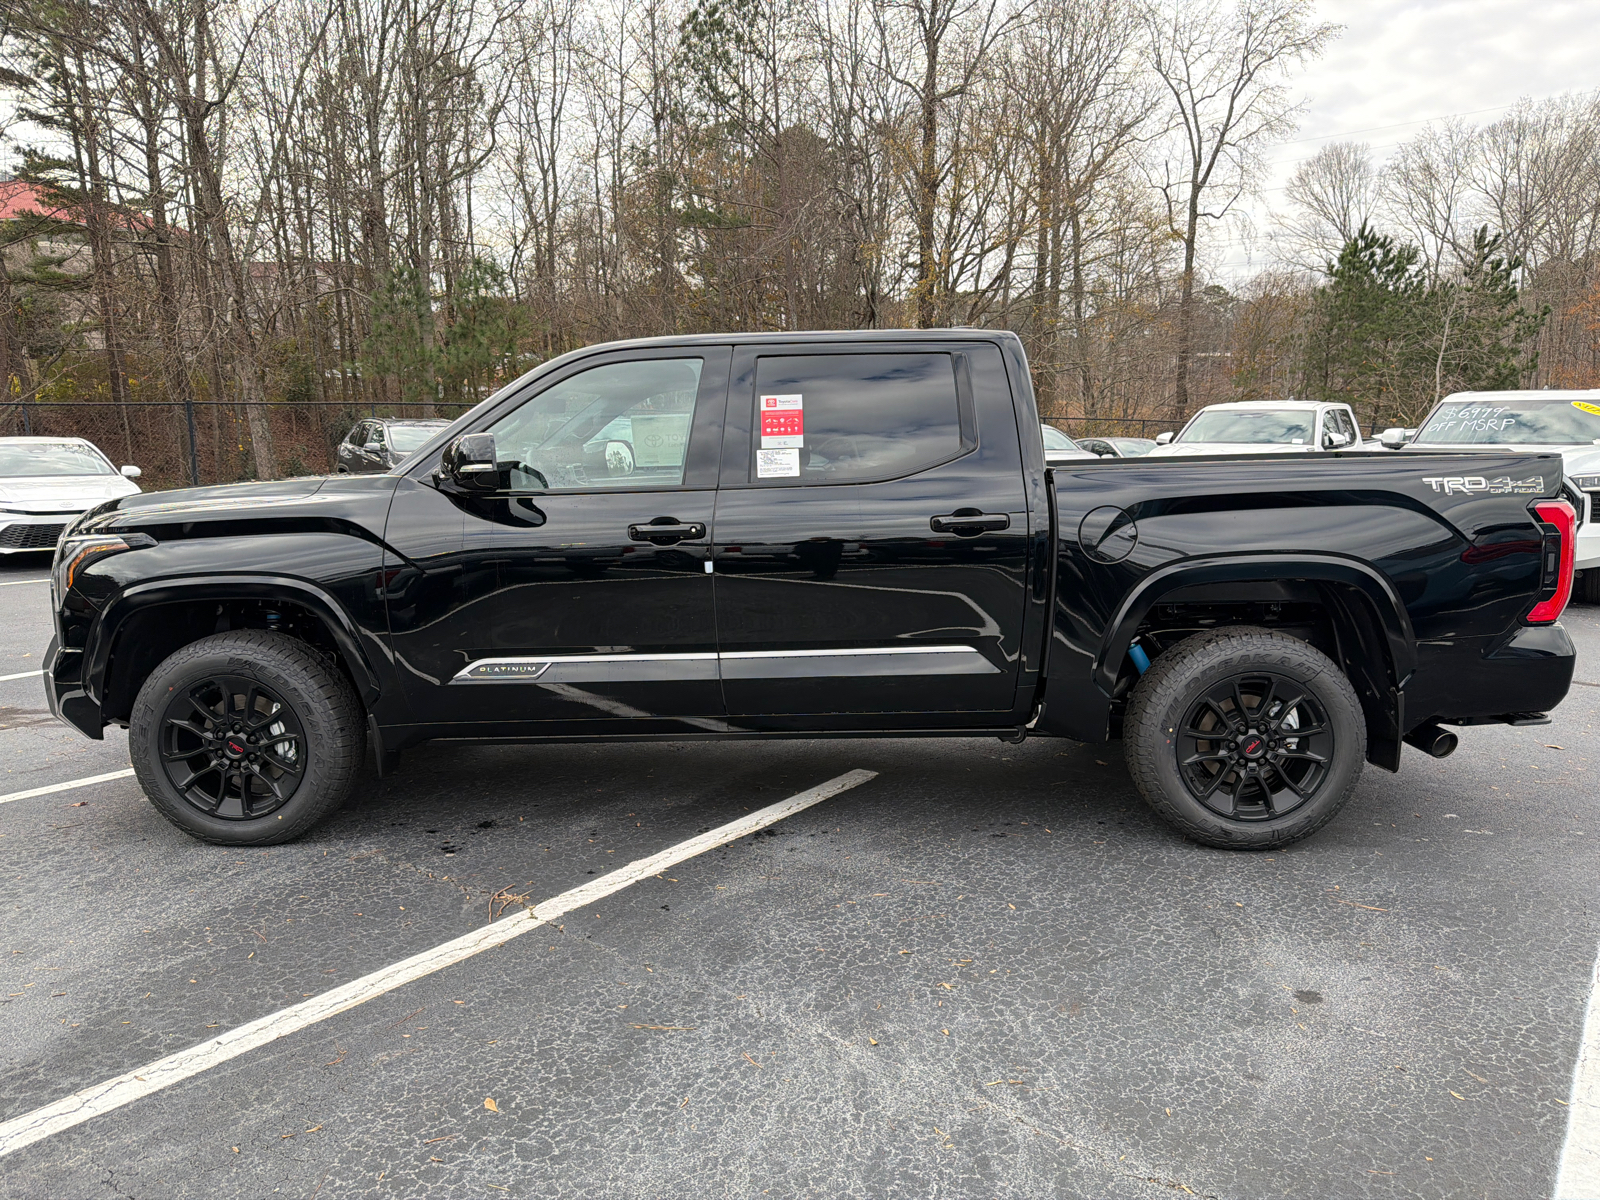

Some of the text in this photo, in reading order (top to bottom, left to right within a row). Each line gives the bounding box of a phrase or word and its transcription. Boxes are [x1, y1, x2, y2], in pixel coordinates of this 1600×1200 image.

[1428, 418, 1516, 432] OFF MSRP
[665, 433, 687, 441] TOY
[1421, 476, 1489, 496] TRD
[1159, 654, 1272, 738] WILDPEAK
[229, 741, 243, 753] TRD
